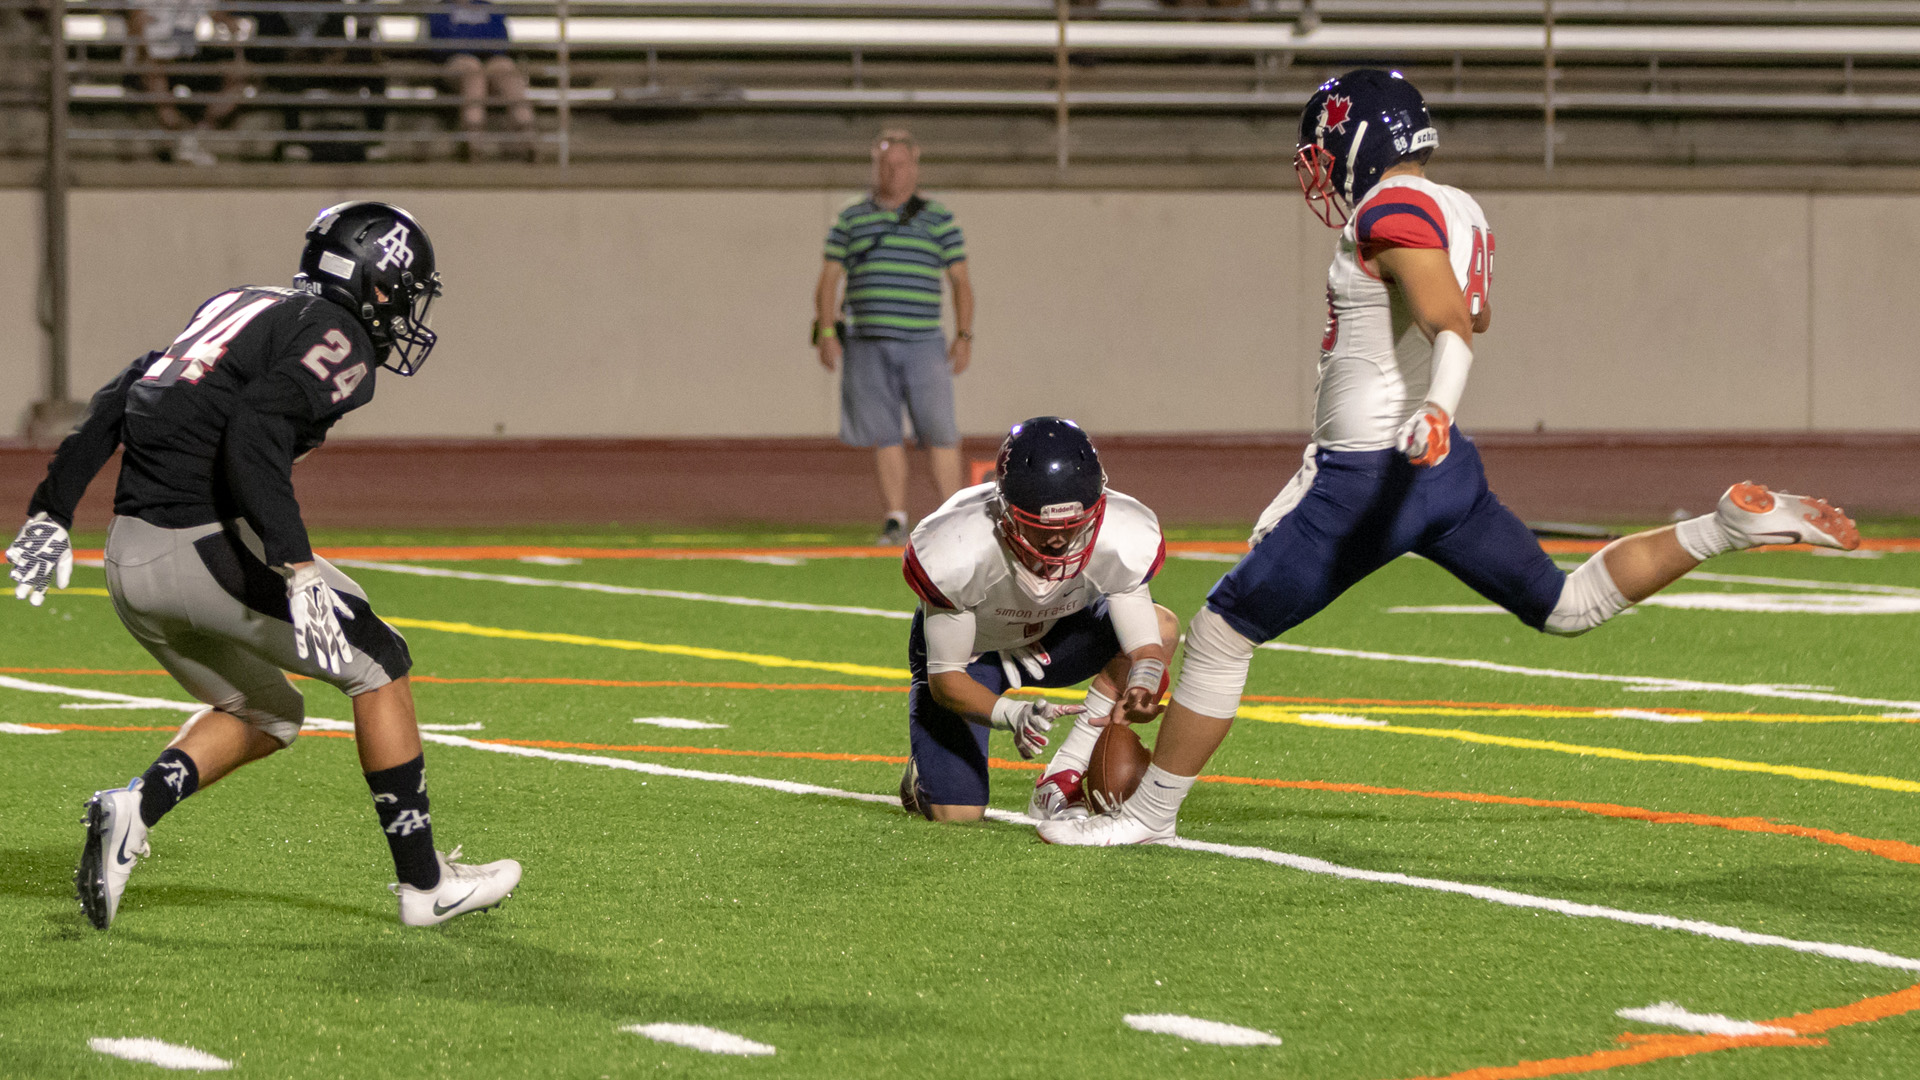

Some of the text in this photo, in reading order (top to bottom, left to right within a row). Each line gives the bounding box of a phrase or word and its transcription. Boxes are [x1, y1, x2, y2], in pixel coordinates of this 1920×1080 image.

[1394, 136, 1408, 151] 88
[300, 328, 368, 404] 24
[1050, 504, 1074, 514] Riddell
